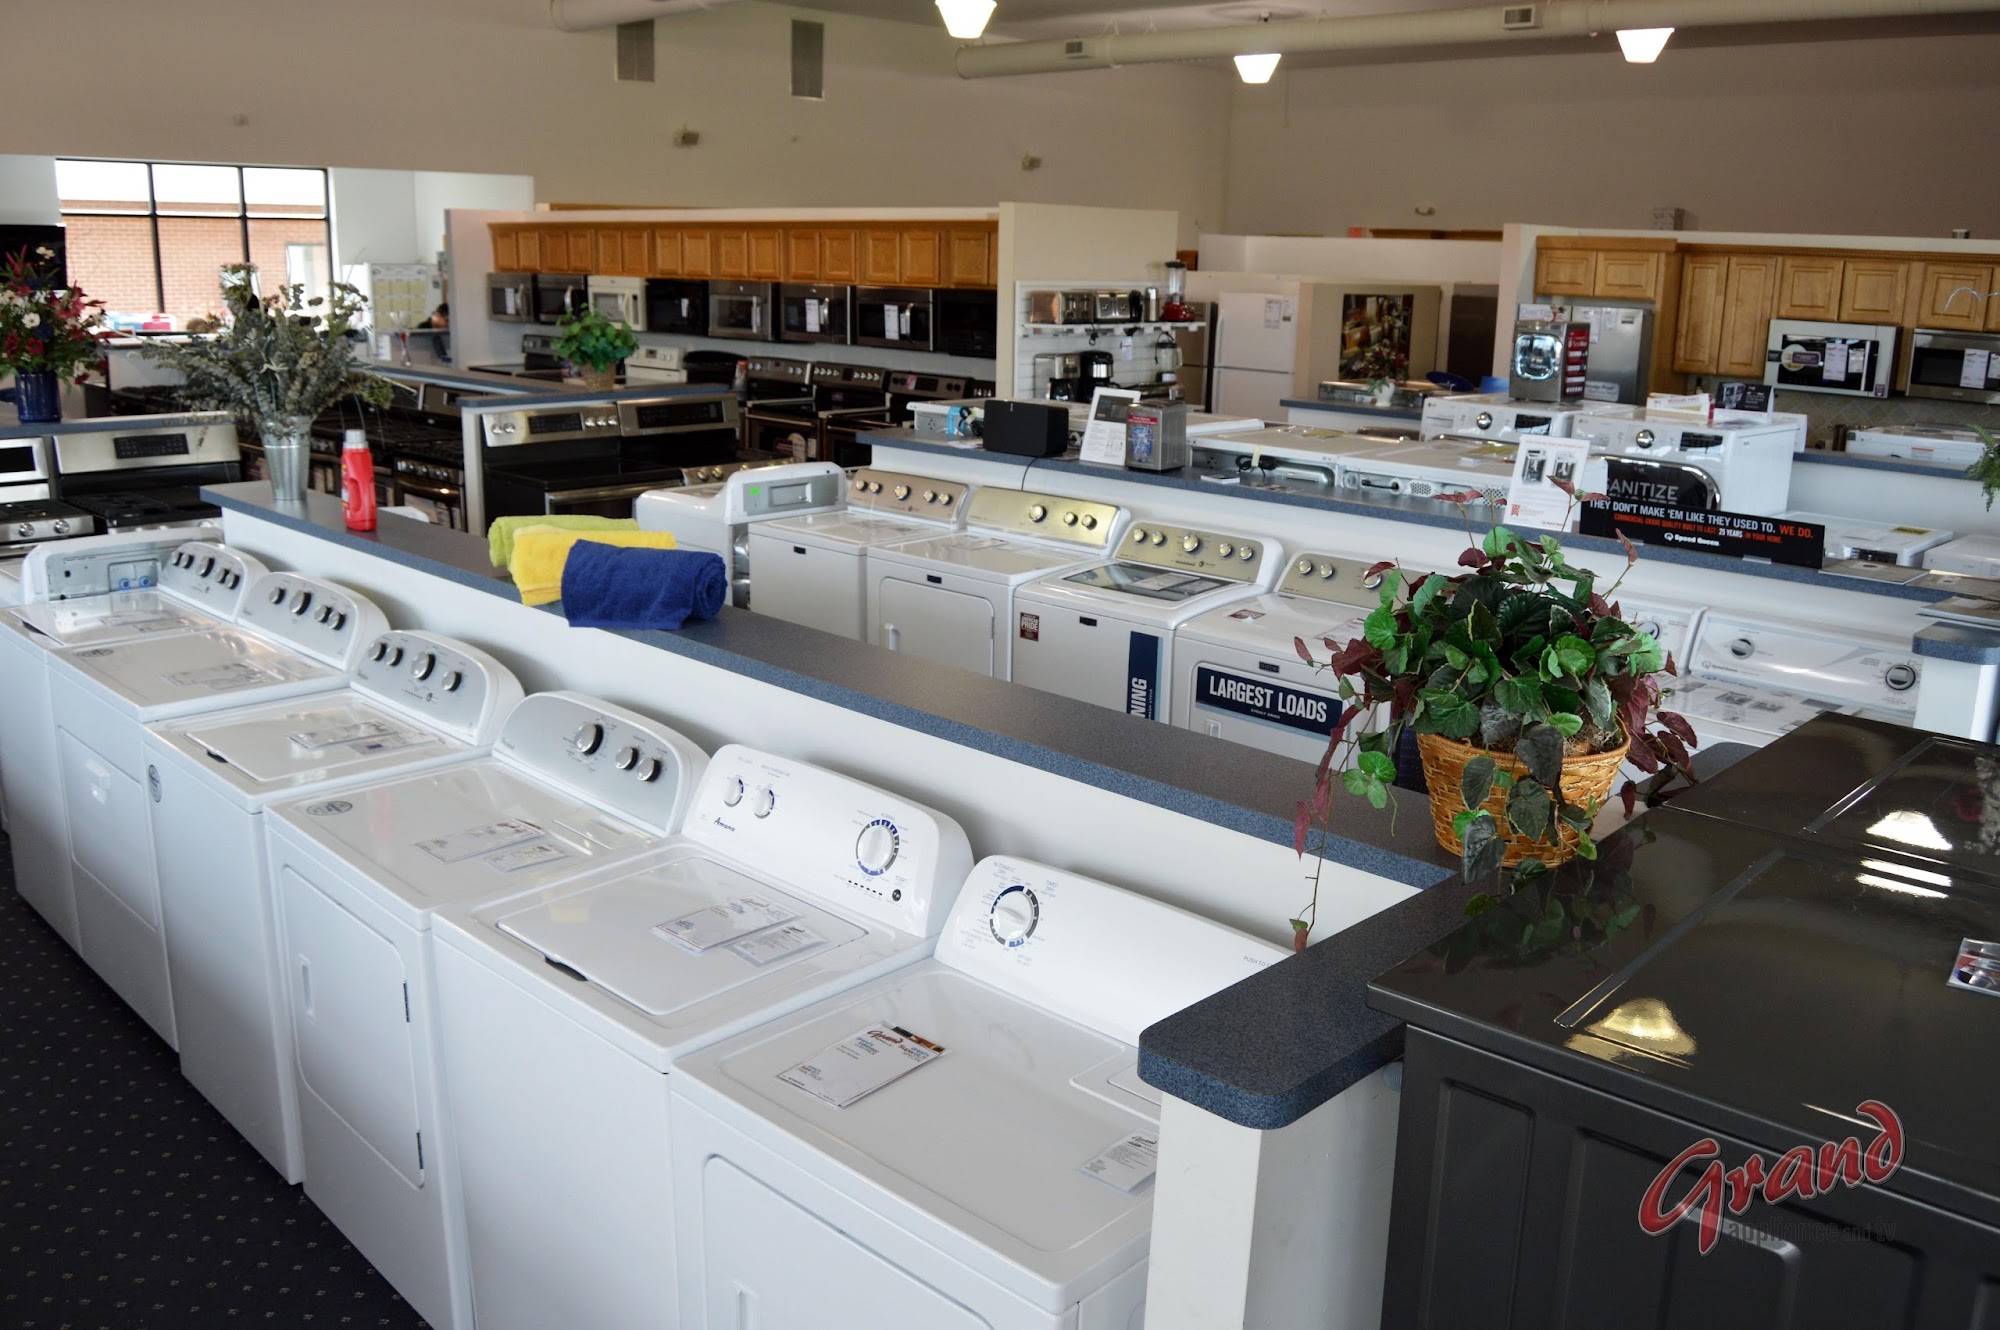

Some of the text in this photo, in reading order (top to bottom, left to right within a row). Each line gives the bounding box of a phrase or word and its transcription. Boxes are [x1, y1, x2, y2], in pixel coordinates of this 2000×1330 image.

[1607, 478, 1679, 501] ANITIZE
[1590, 499, 1611, 510] THEY
[1612, 501, 1638, 513] DON'T
[1640, 505, 1665, 518] MAKE
[1685, 512, 1705, 523] LIKE
[1707, 514, 1731, 527] THEY
[1733, 518, 1758, 531] USED
[1761, 522, 1776, 533] TO.
[1780, 524, 1795, 536] WE
[1797, 527, 1814, 539] DO.
[1719, 527, 1726, 536] 25
[1726, 528, 1743, 538] YEARS
[1674, 534, 1720, 547] Speed Queen
[1021, 620, 1038, 631] PRIDE
[1209, 675, 1328, 723] LARGEST LOADS
[713, 817, 736, 832] Amana
[1243, 955, 1258, 964] PUSH
